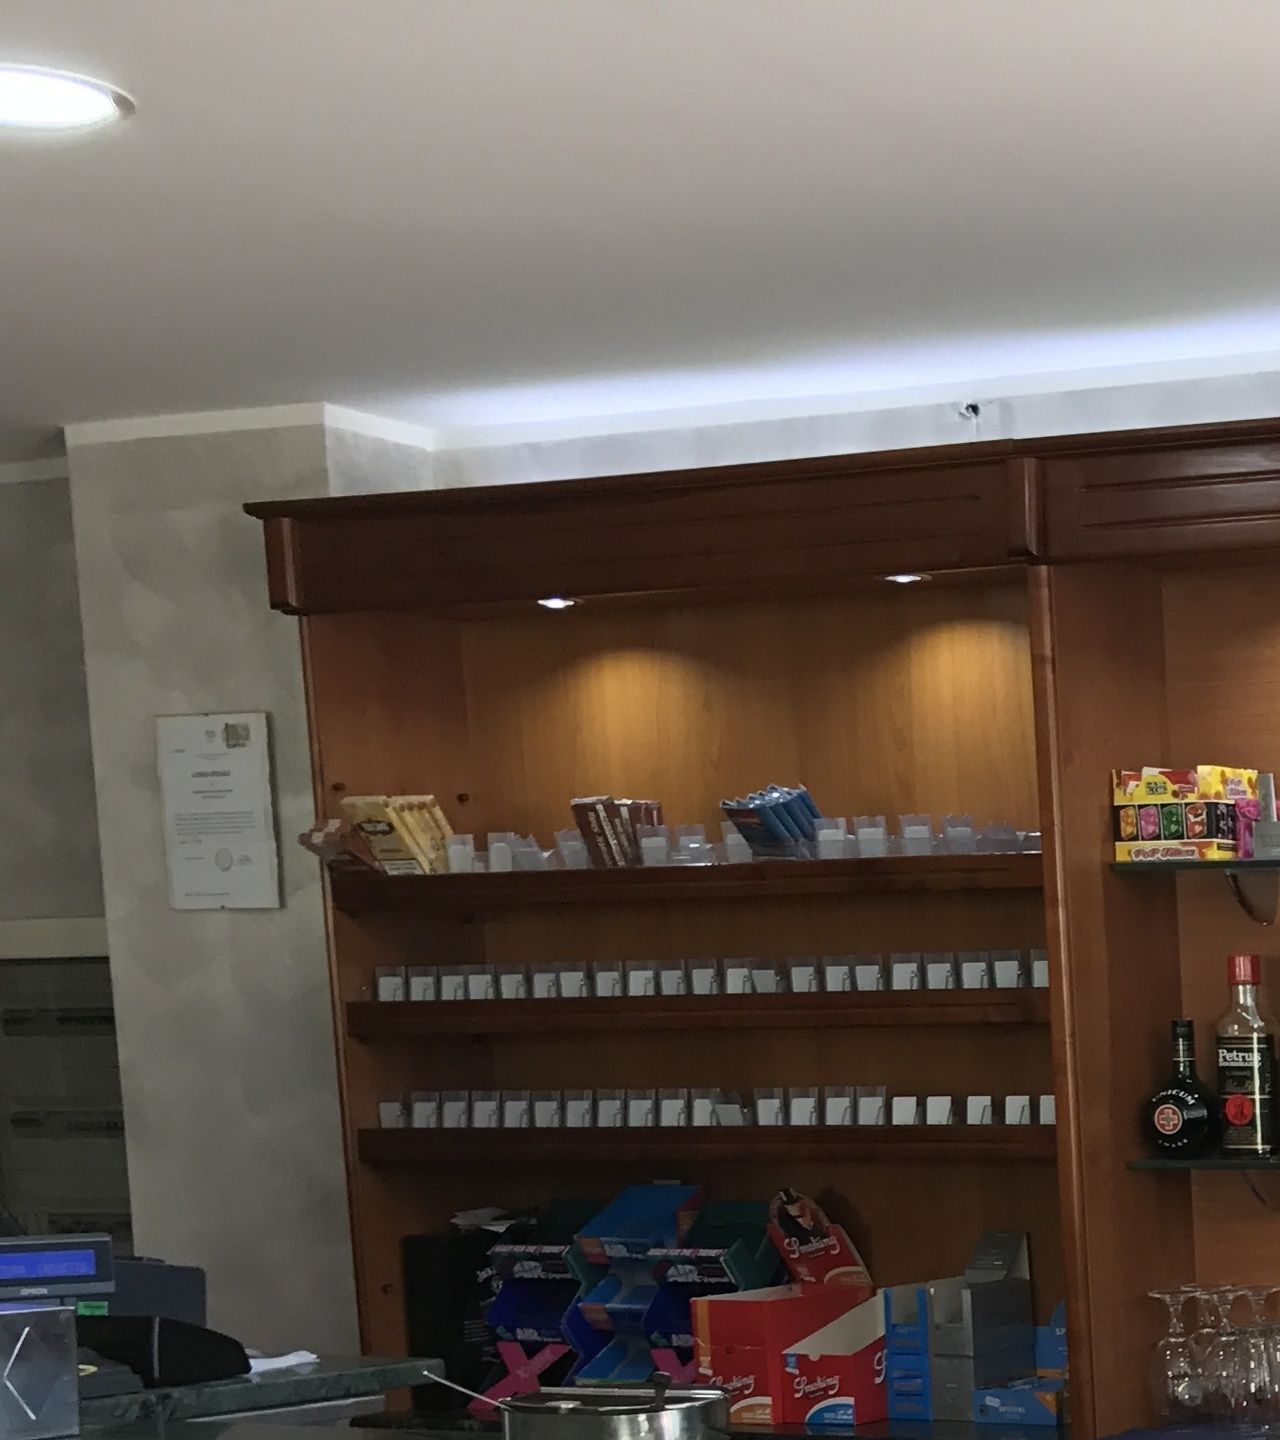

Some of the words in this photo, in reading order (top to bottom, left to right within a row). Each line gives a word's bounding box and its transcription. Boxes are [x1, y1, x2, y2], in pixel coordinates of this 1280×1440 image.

[1218, 1049, 1262, 1061] Petrus
[783, 1235, 841, 1259] Smoking
[793, 1374, 841, 1398] Smoking
